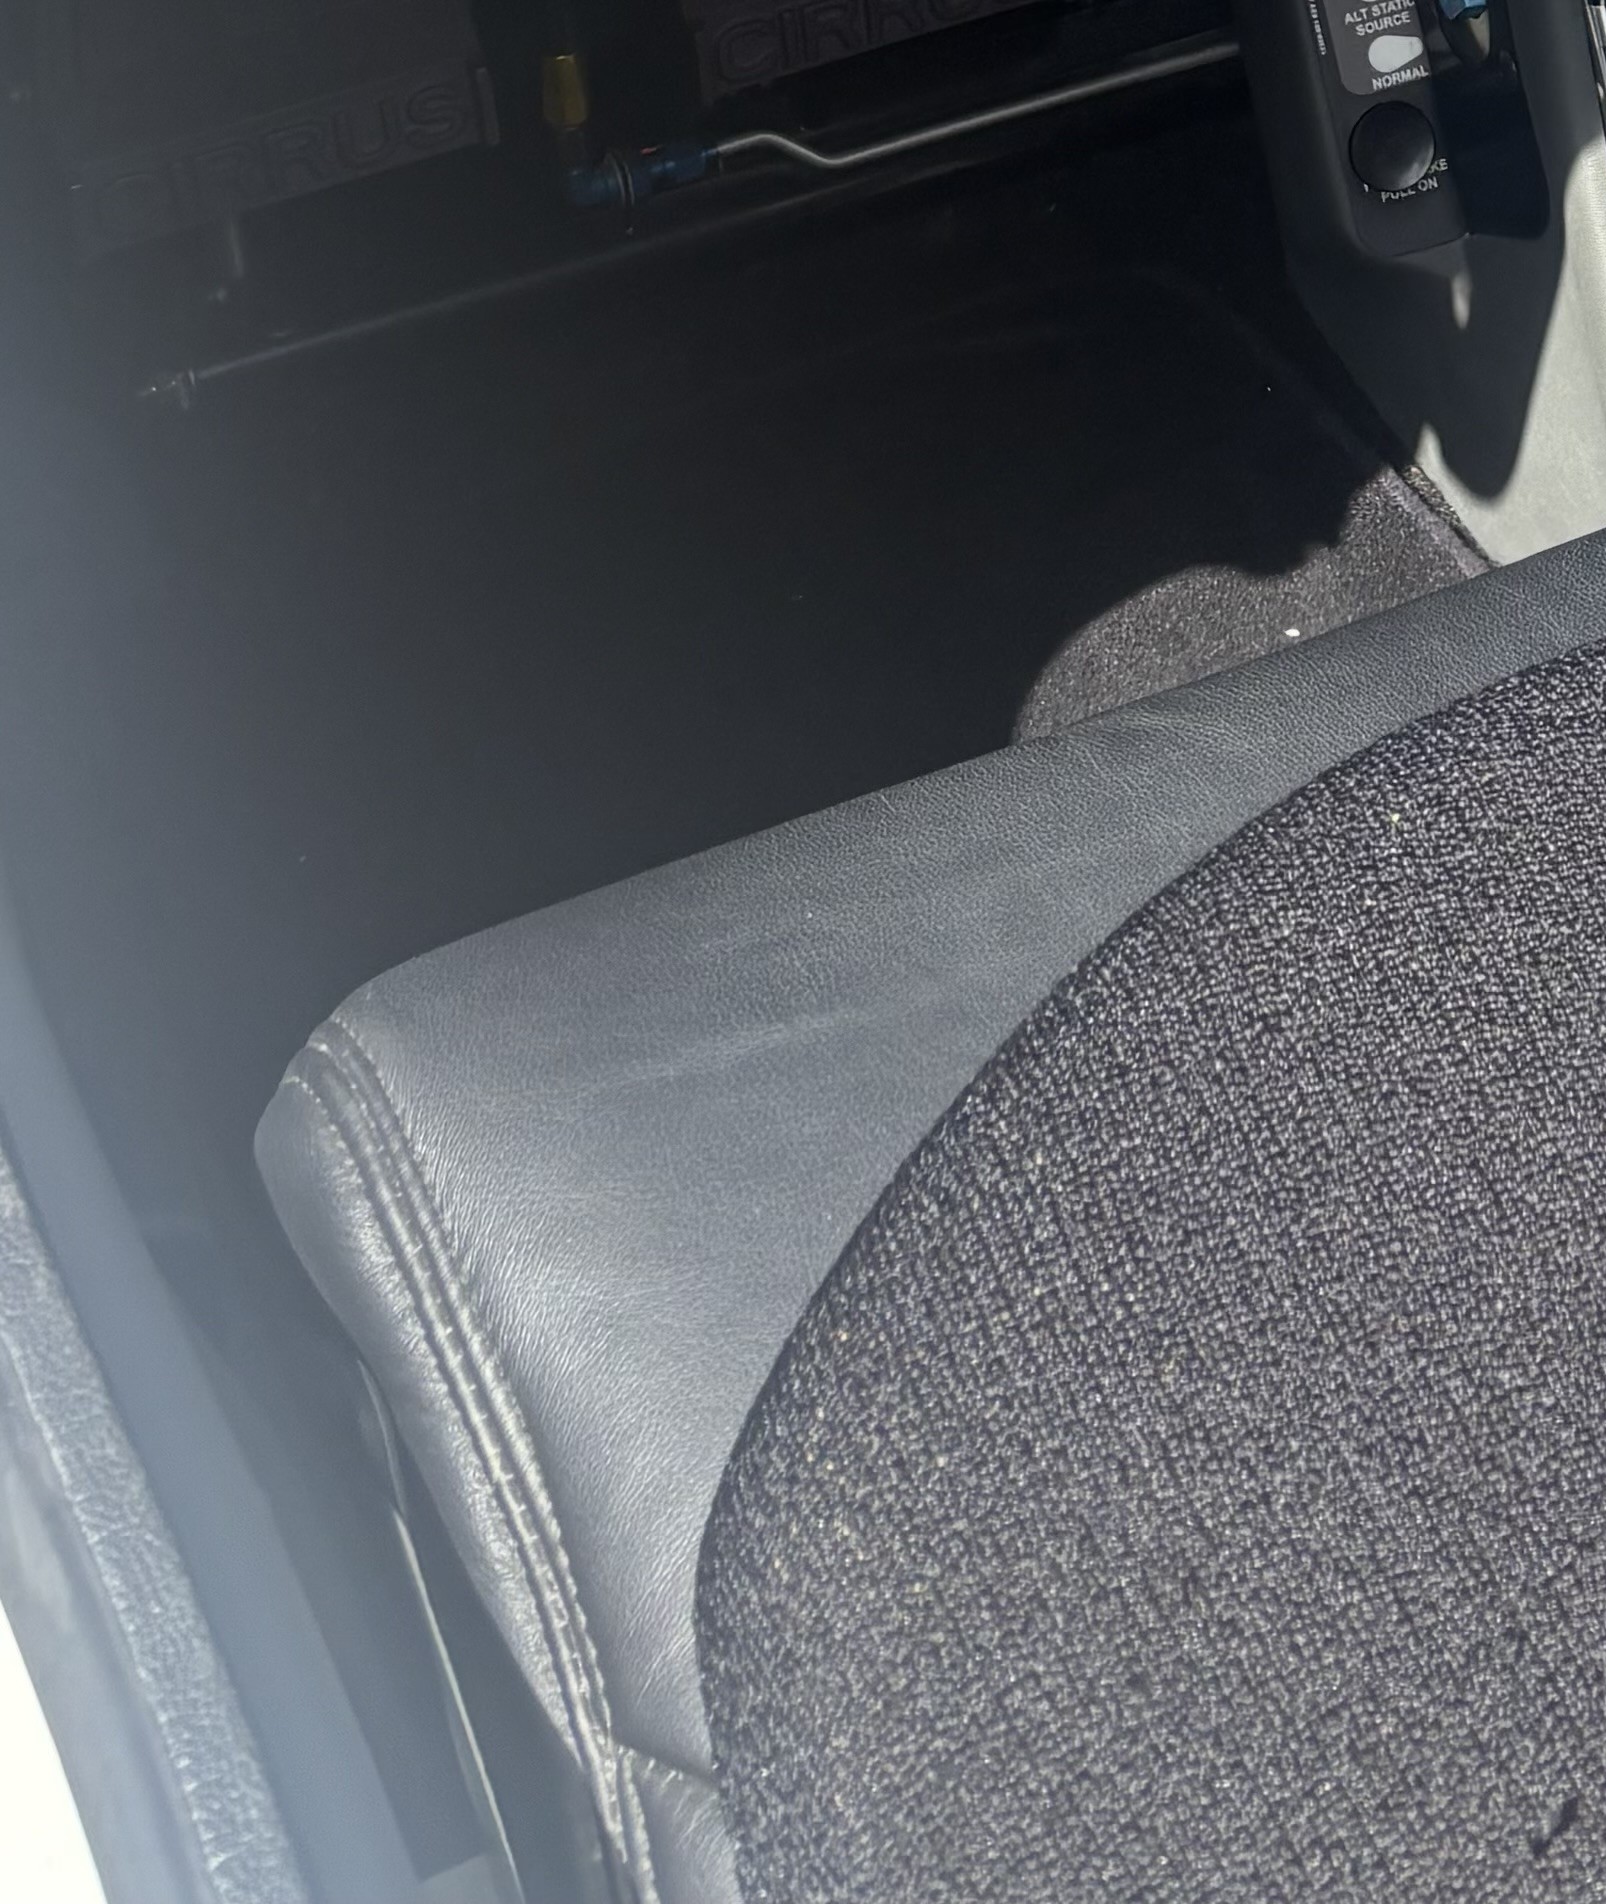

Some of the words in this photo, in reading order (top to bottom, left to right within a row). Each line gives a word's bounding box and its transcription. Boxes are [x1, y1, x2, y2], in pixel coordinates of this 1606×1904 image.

[1344, 7, 1370, 26] ALT
[1355, 10, 1411, 36] SOURCE
[1371, 64, 1429, 91] NORMAL
